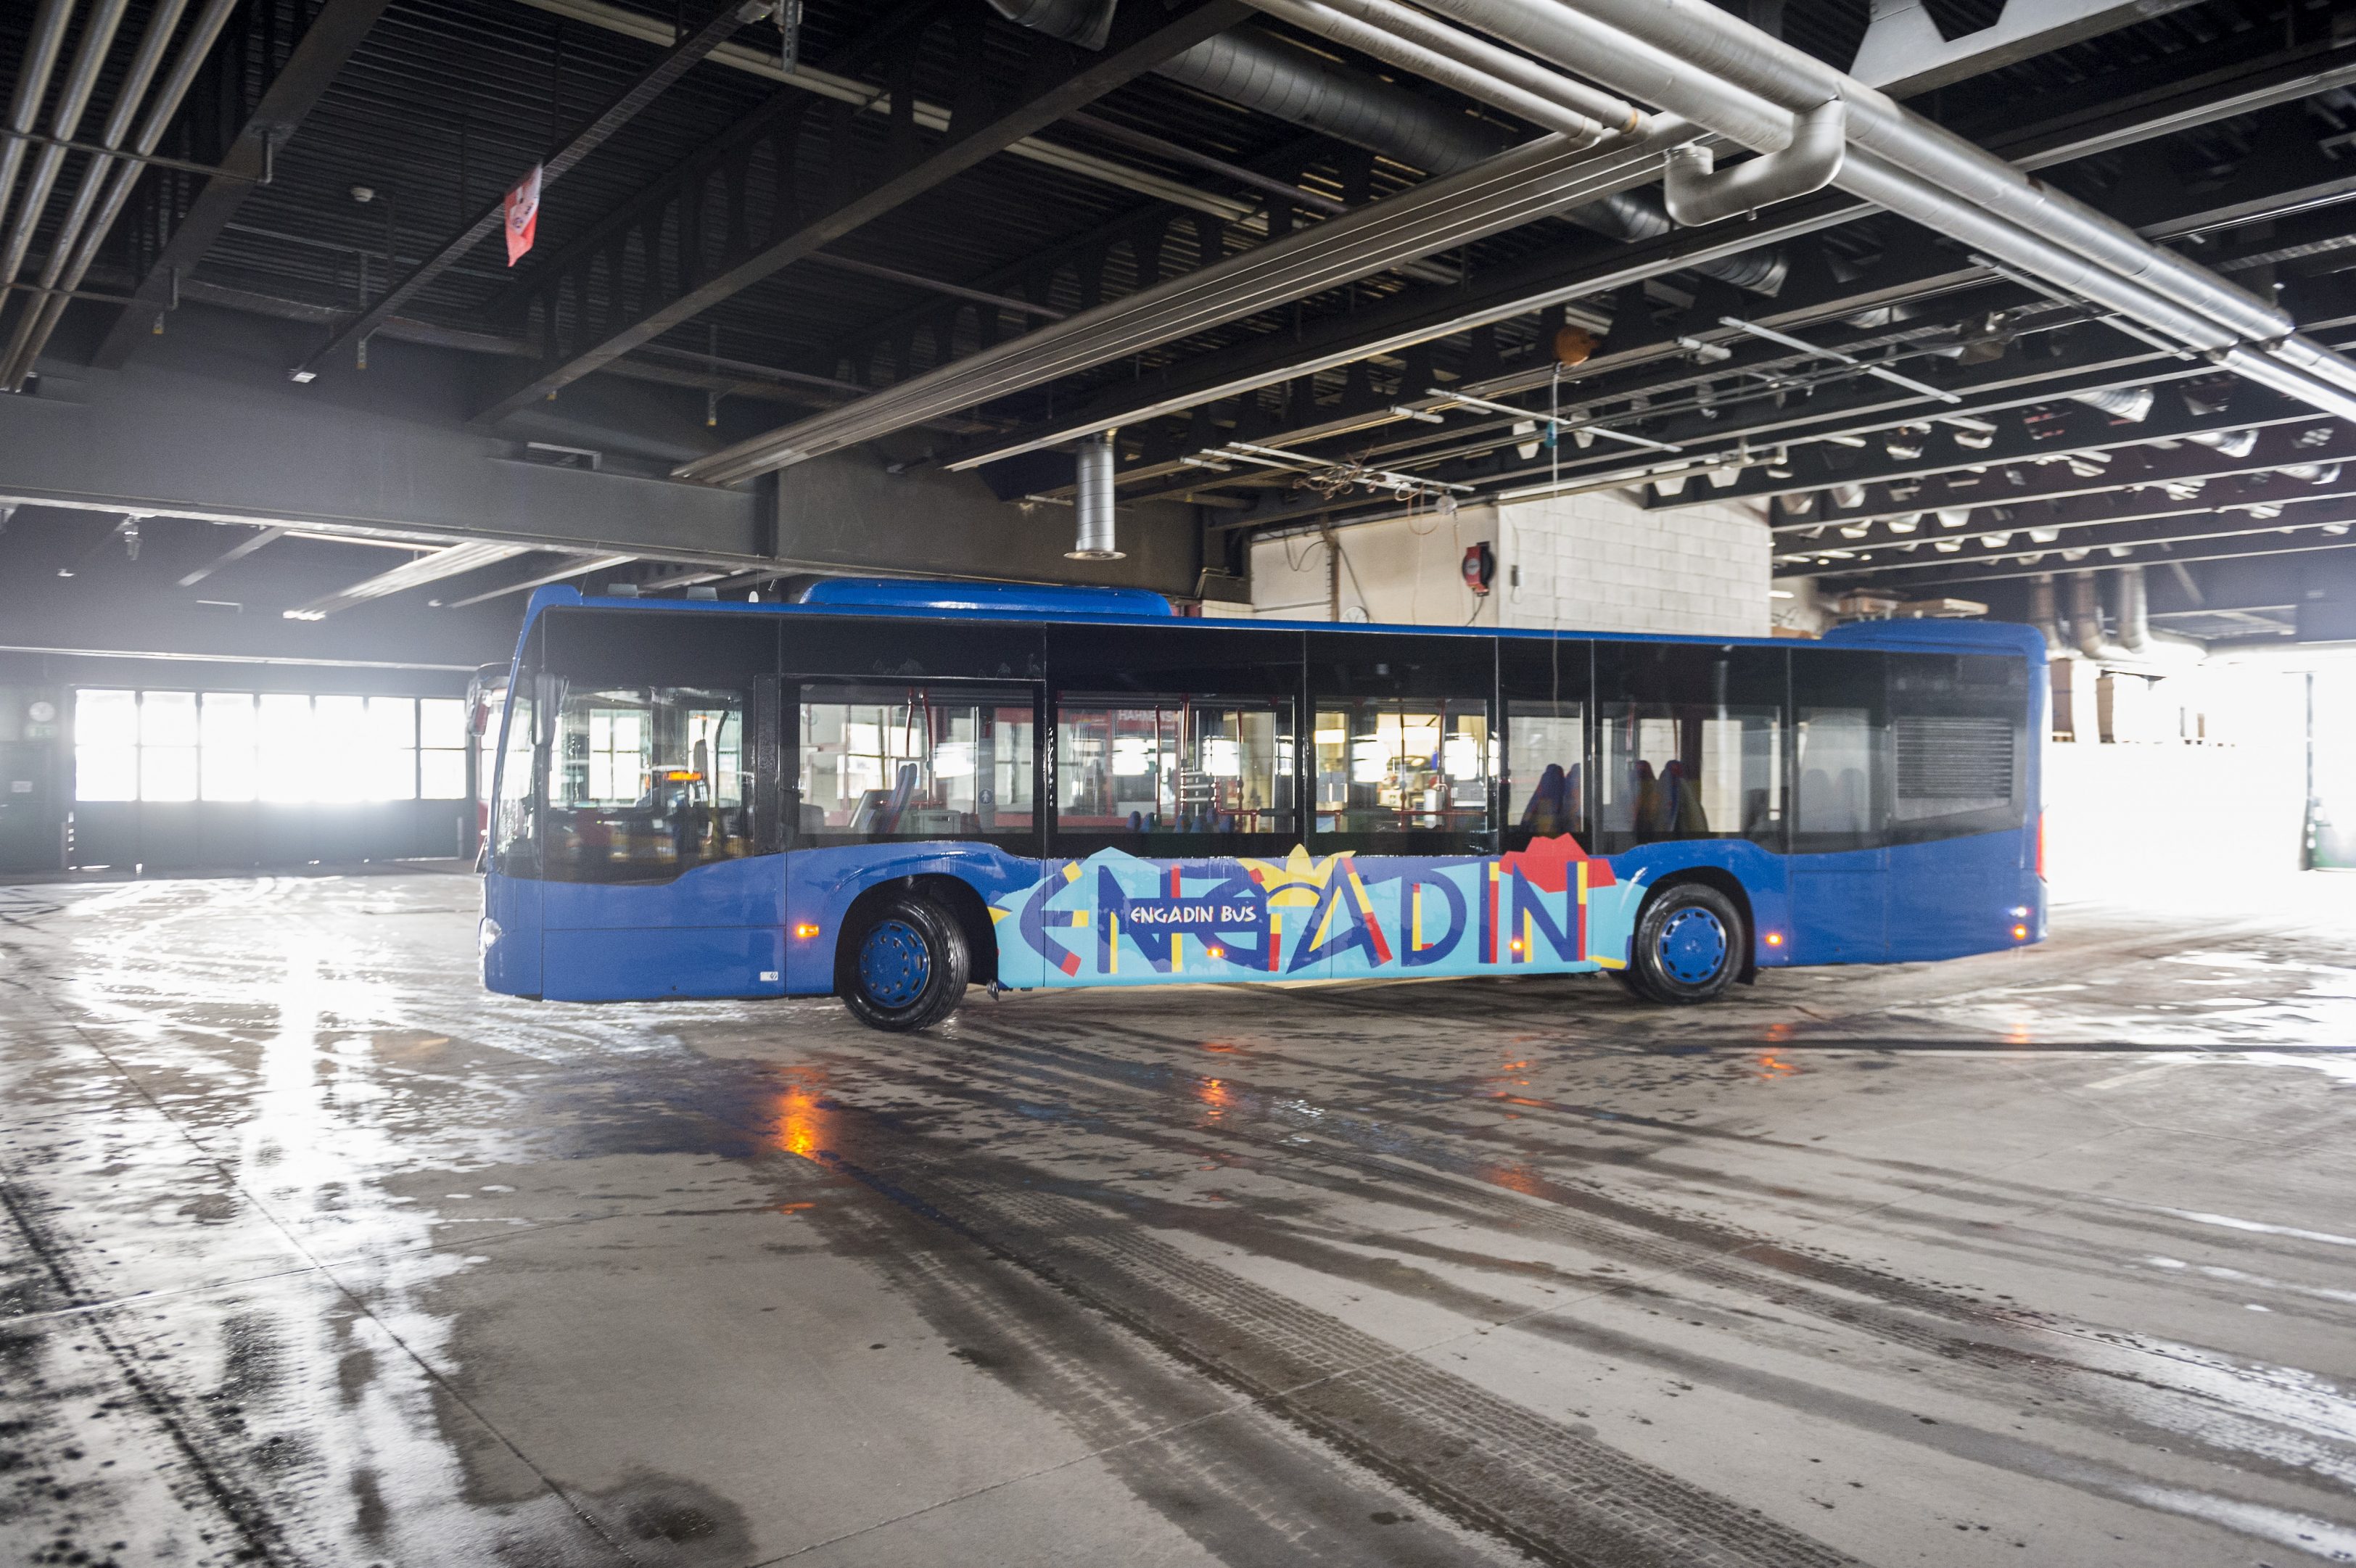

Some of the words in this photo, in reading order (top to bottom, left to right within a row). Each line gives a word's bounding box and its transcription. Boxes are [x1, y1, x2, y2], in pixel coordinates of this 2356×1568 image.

[1020, 858, 1588, 977] ENGADIN
[1130, 905, 1214, 924] ENGADIN
[1221, 904, 1256, 923] BUS
